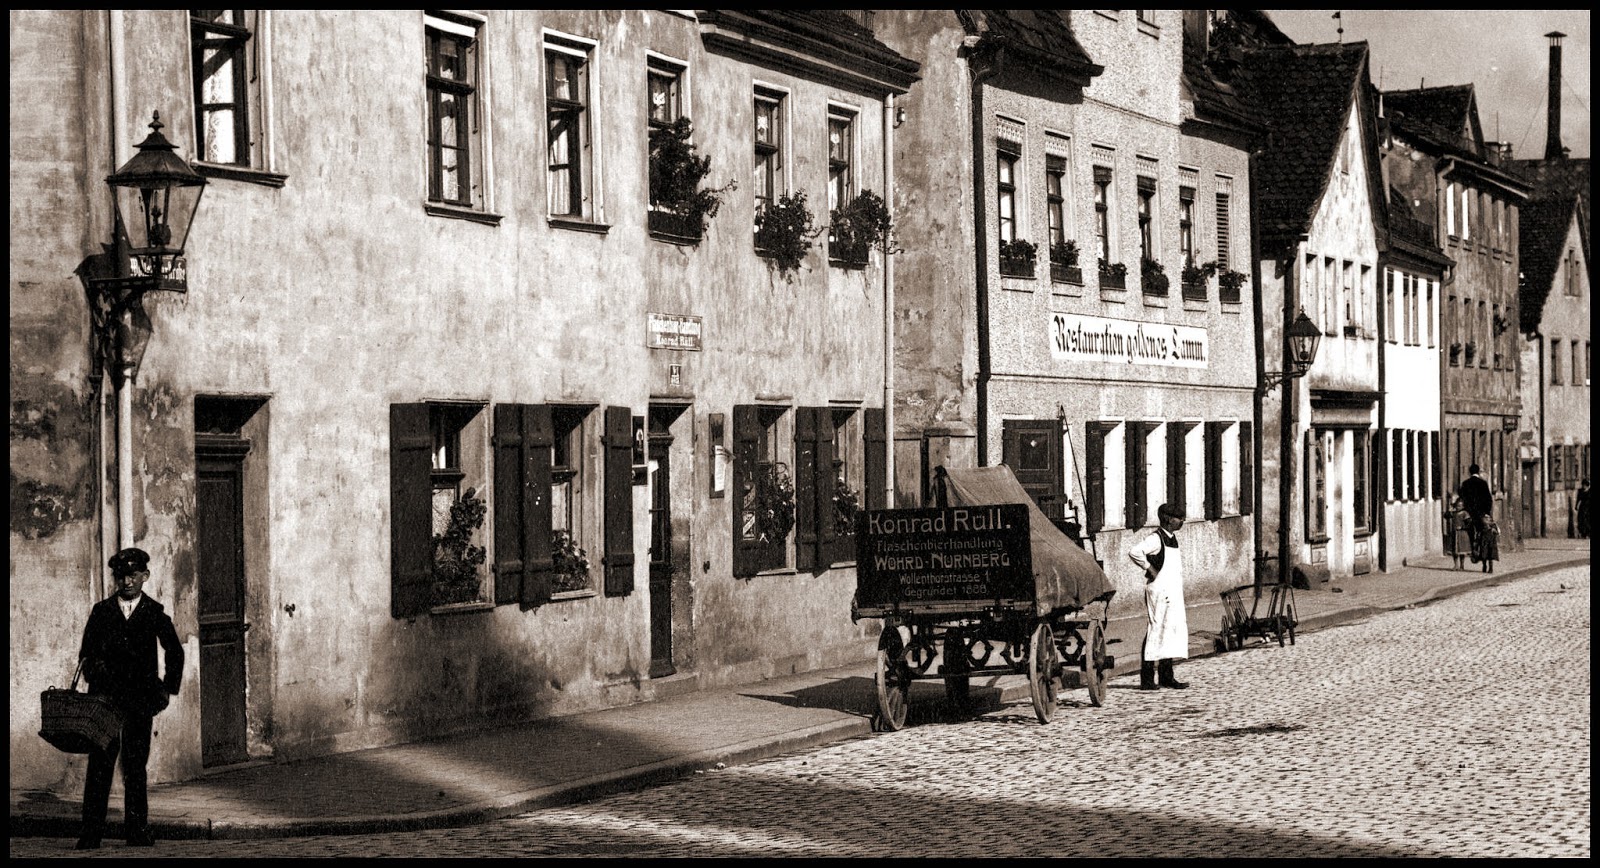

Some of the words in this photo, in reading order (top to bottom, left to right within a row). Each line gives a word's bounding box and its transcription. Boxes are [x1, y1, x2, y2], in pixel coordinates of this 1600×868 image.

[1053, 314, 1124, 357] Restauration
[1126, 324, 1168, 364] goldenes
[1171, 327, 1206, 362] Lamm.
[868, 511, 946, 535] Konrad
[953, 508, 1012, 531] Rüll.
[877, 536, 1004, 553] Flaschenbierhandlung
[898, 572, 981, 585] Wollenthorstrasse
